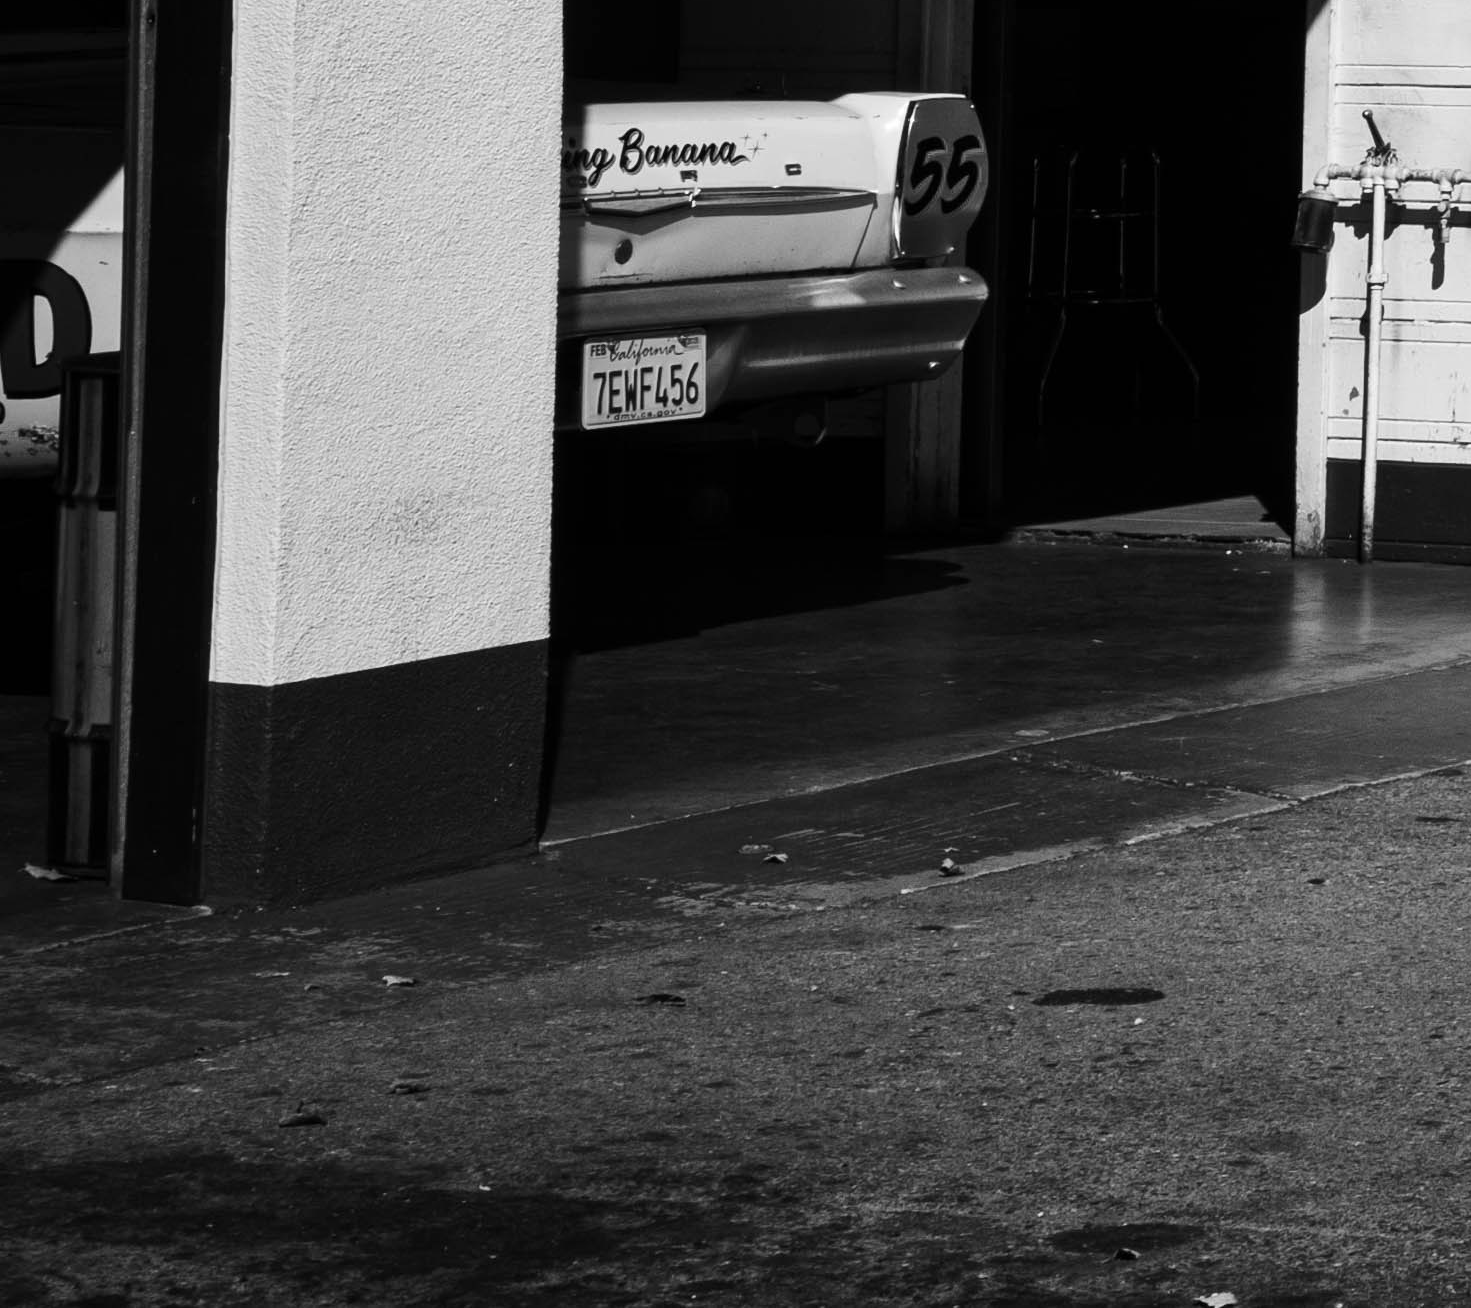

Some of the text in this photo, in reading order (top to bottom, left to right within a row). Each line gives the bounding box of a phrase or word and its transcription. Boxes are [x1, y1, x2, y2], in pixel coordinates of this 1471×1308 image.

[618, 128, 750, 175] Banana
[903, 134, 981, 216] 55
[590, 338, 684, 366] FEB California
[593, 362, 699, 415] 7EWF456
[614, 409, 677, 420] dmv.ca.gov
